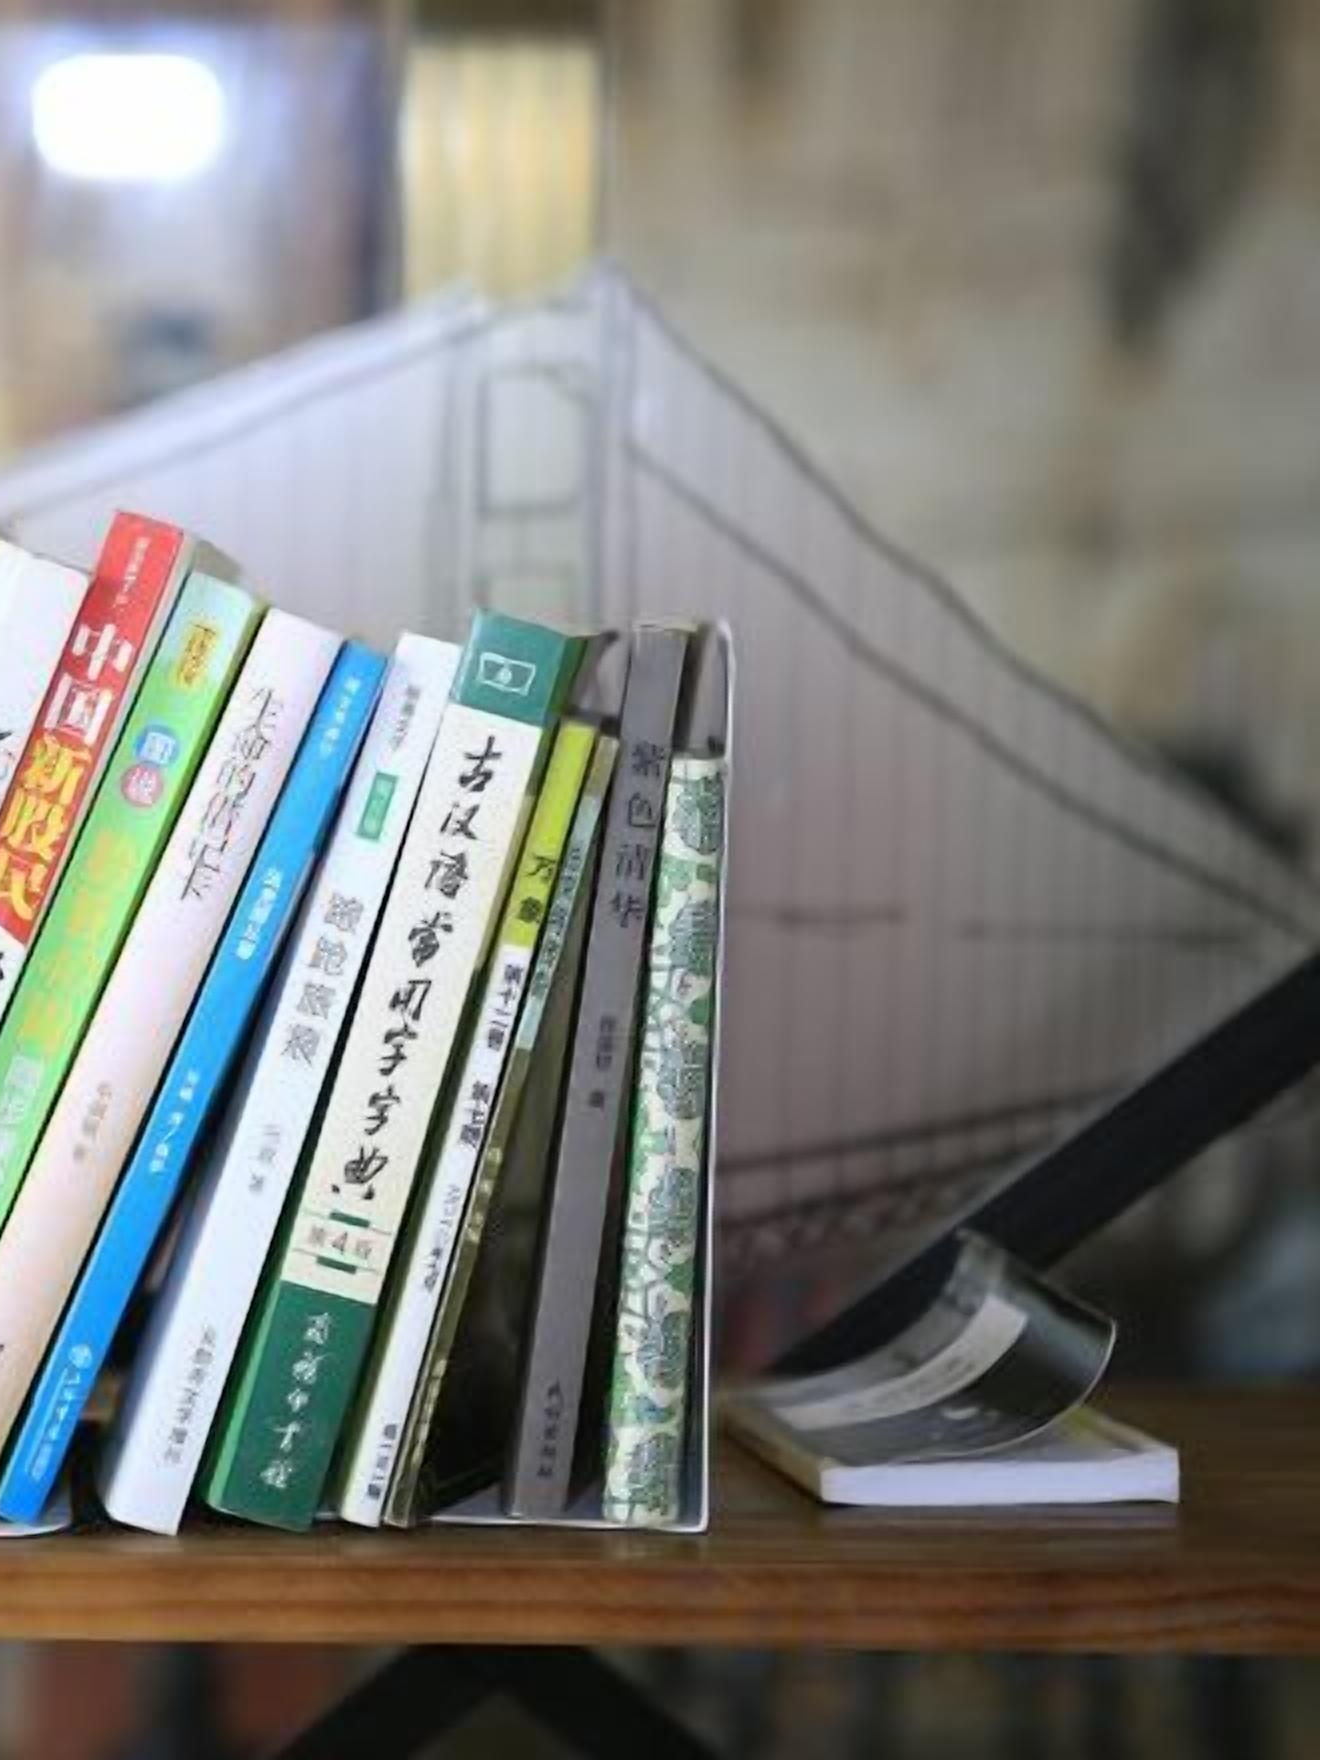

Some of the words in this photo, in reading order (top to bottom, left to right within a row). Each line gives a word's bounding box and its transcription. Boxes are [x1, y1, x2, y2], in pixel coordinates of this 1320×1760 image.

[330, 734, 503, 1202] 古汉语常用字字典
